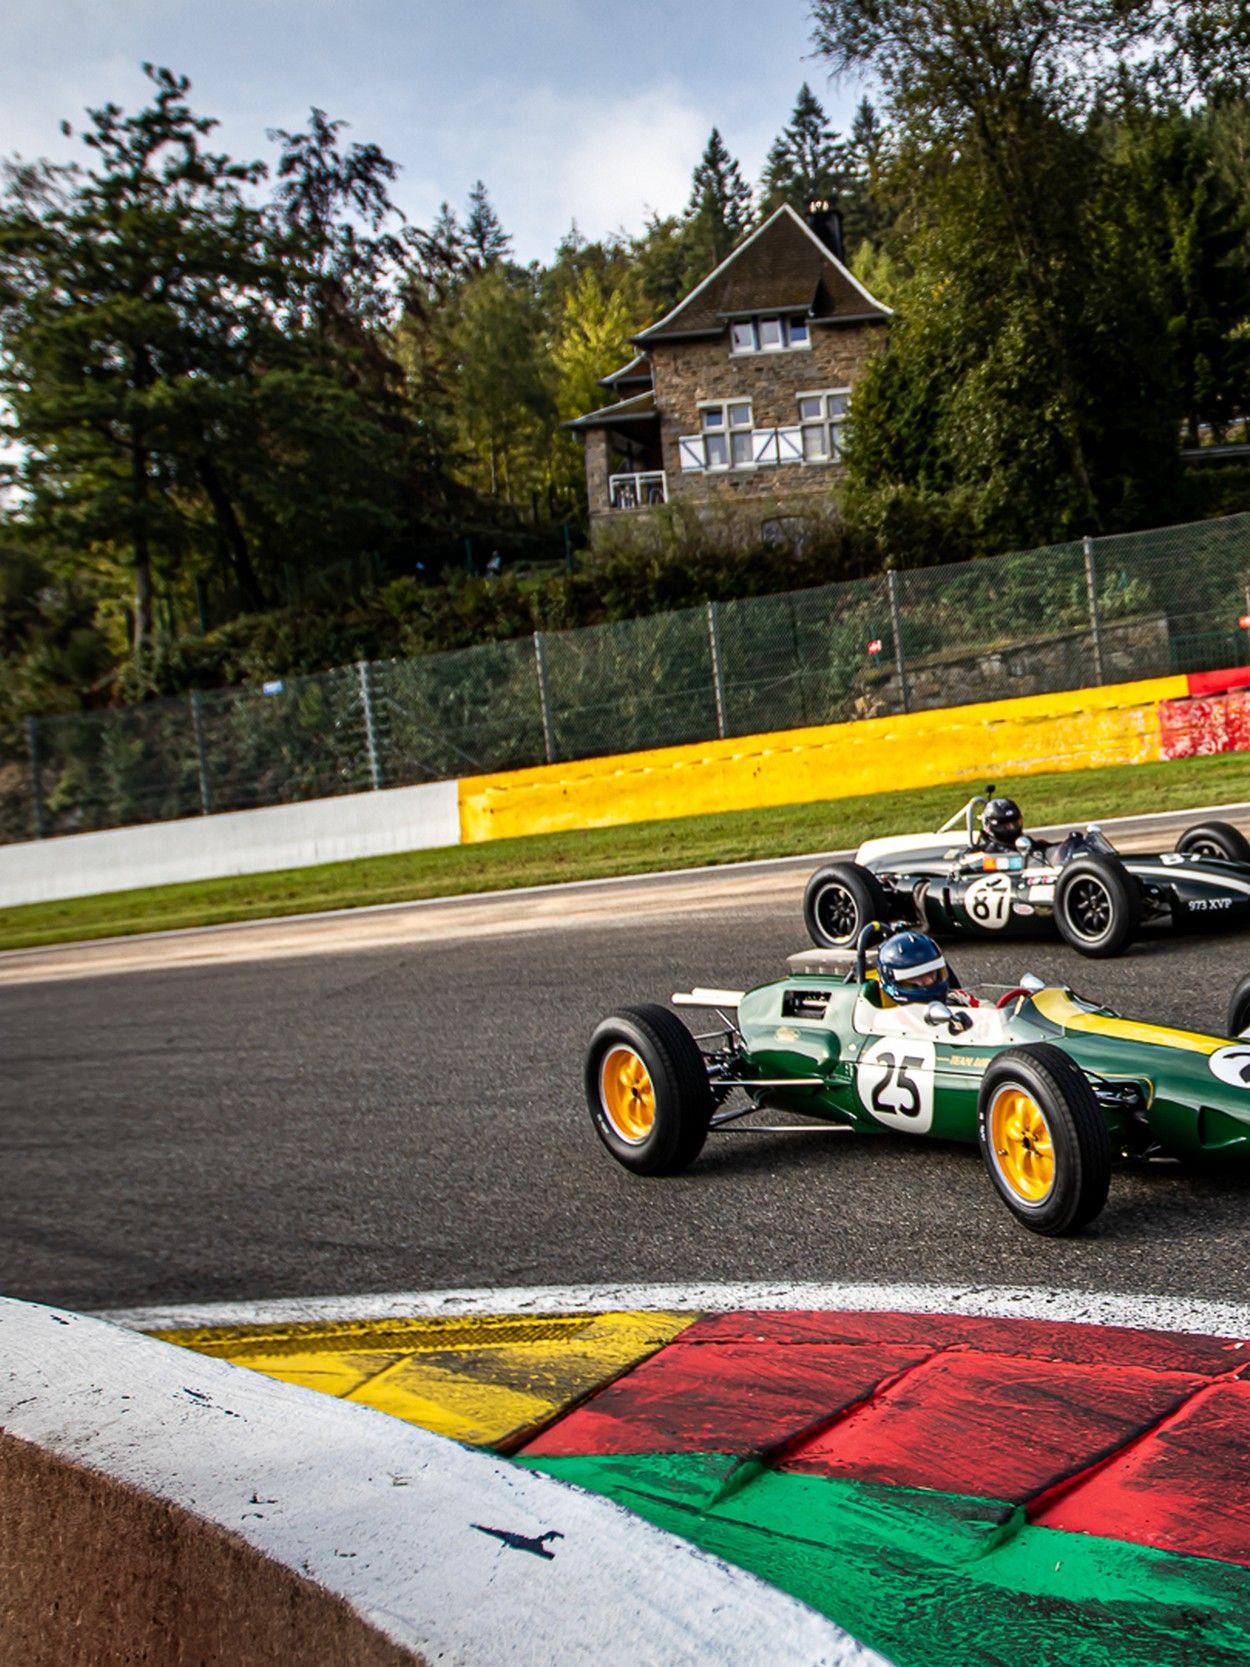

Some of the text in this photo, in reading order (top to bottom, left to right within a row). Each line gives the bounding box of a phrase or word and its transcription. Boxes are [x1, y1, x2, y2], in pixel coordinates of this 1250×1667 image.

[972, 878, 1008, 920] 87
[1188, 898, 1232, 911] 973 XVP
[871, 1051, 925, 1118] 25
